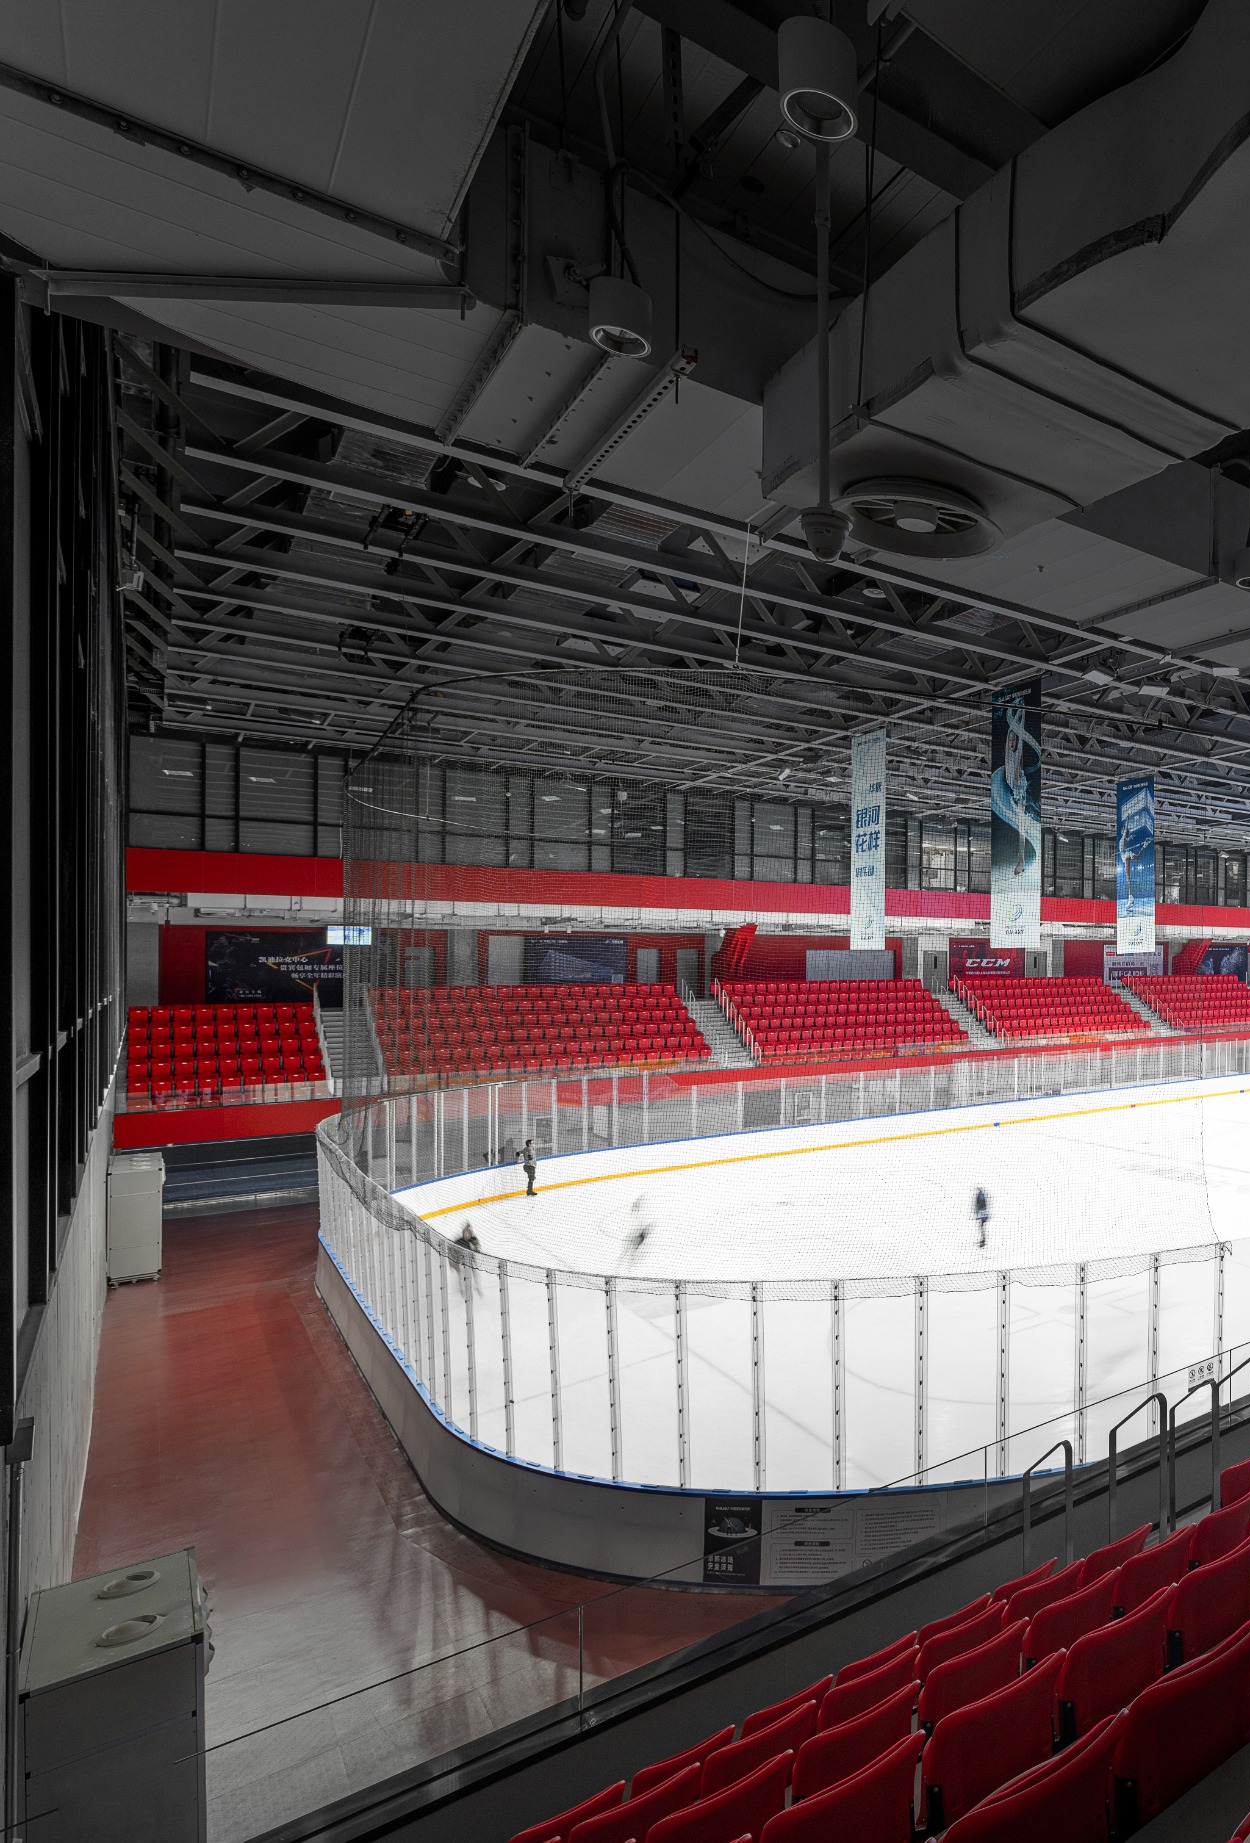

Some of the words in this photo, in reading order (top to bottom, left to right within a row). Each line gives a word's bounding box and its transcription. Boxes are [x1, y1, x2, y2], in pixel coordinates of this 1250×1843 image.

[856, 805, 880, 828] 银河
[856, 830, 880, 853] 花样
[965, 958, 1011, 967] CCM
